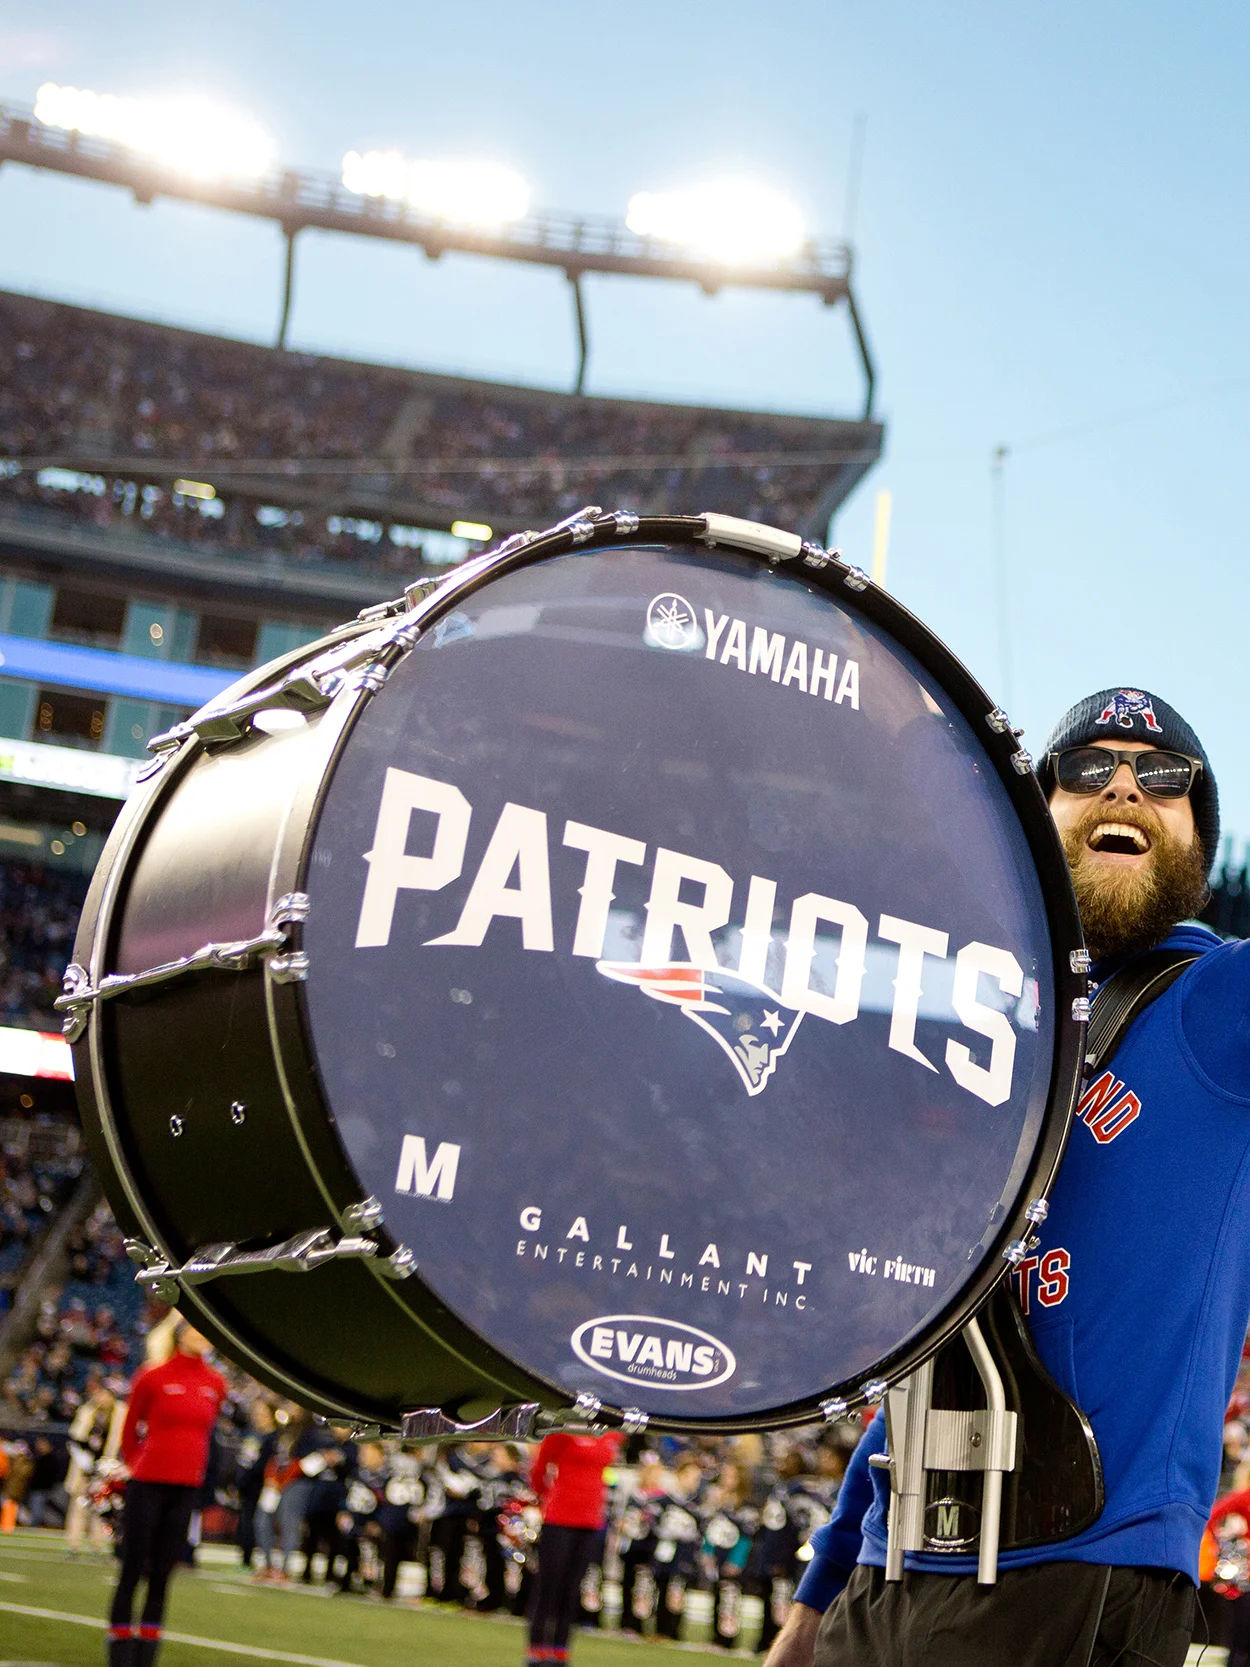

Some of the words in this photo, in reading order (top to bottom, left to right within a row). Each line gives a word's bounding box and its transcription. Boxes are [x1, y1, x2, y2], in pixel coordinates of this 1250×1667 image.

[704, 607, 860, 711] YAMAHA
[354, 766, 1025, 1107] PATRIOTS
[395, 1133, 462, 1200] M
[516, 1240, 749, 1299] ENTERTAINMENT
[519, 1206, 812, 1285] GALLANT
[1004, 1247, 1071, 1315] TS
[590, 1326, 716, 1376] EVANS
[627, 1362, 678, 1382] drumheads
[936, 1505, 960, 1537] M
